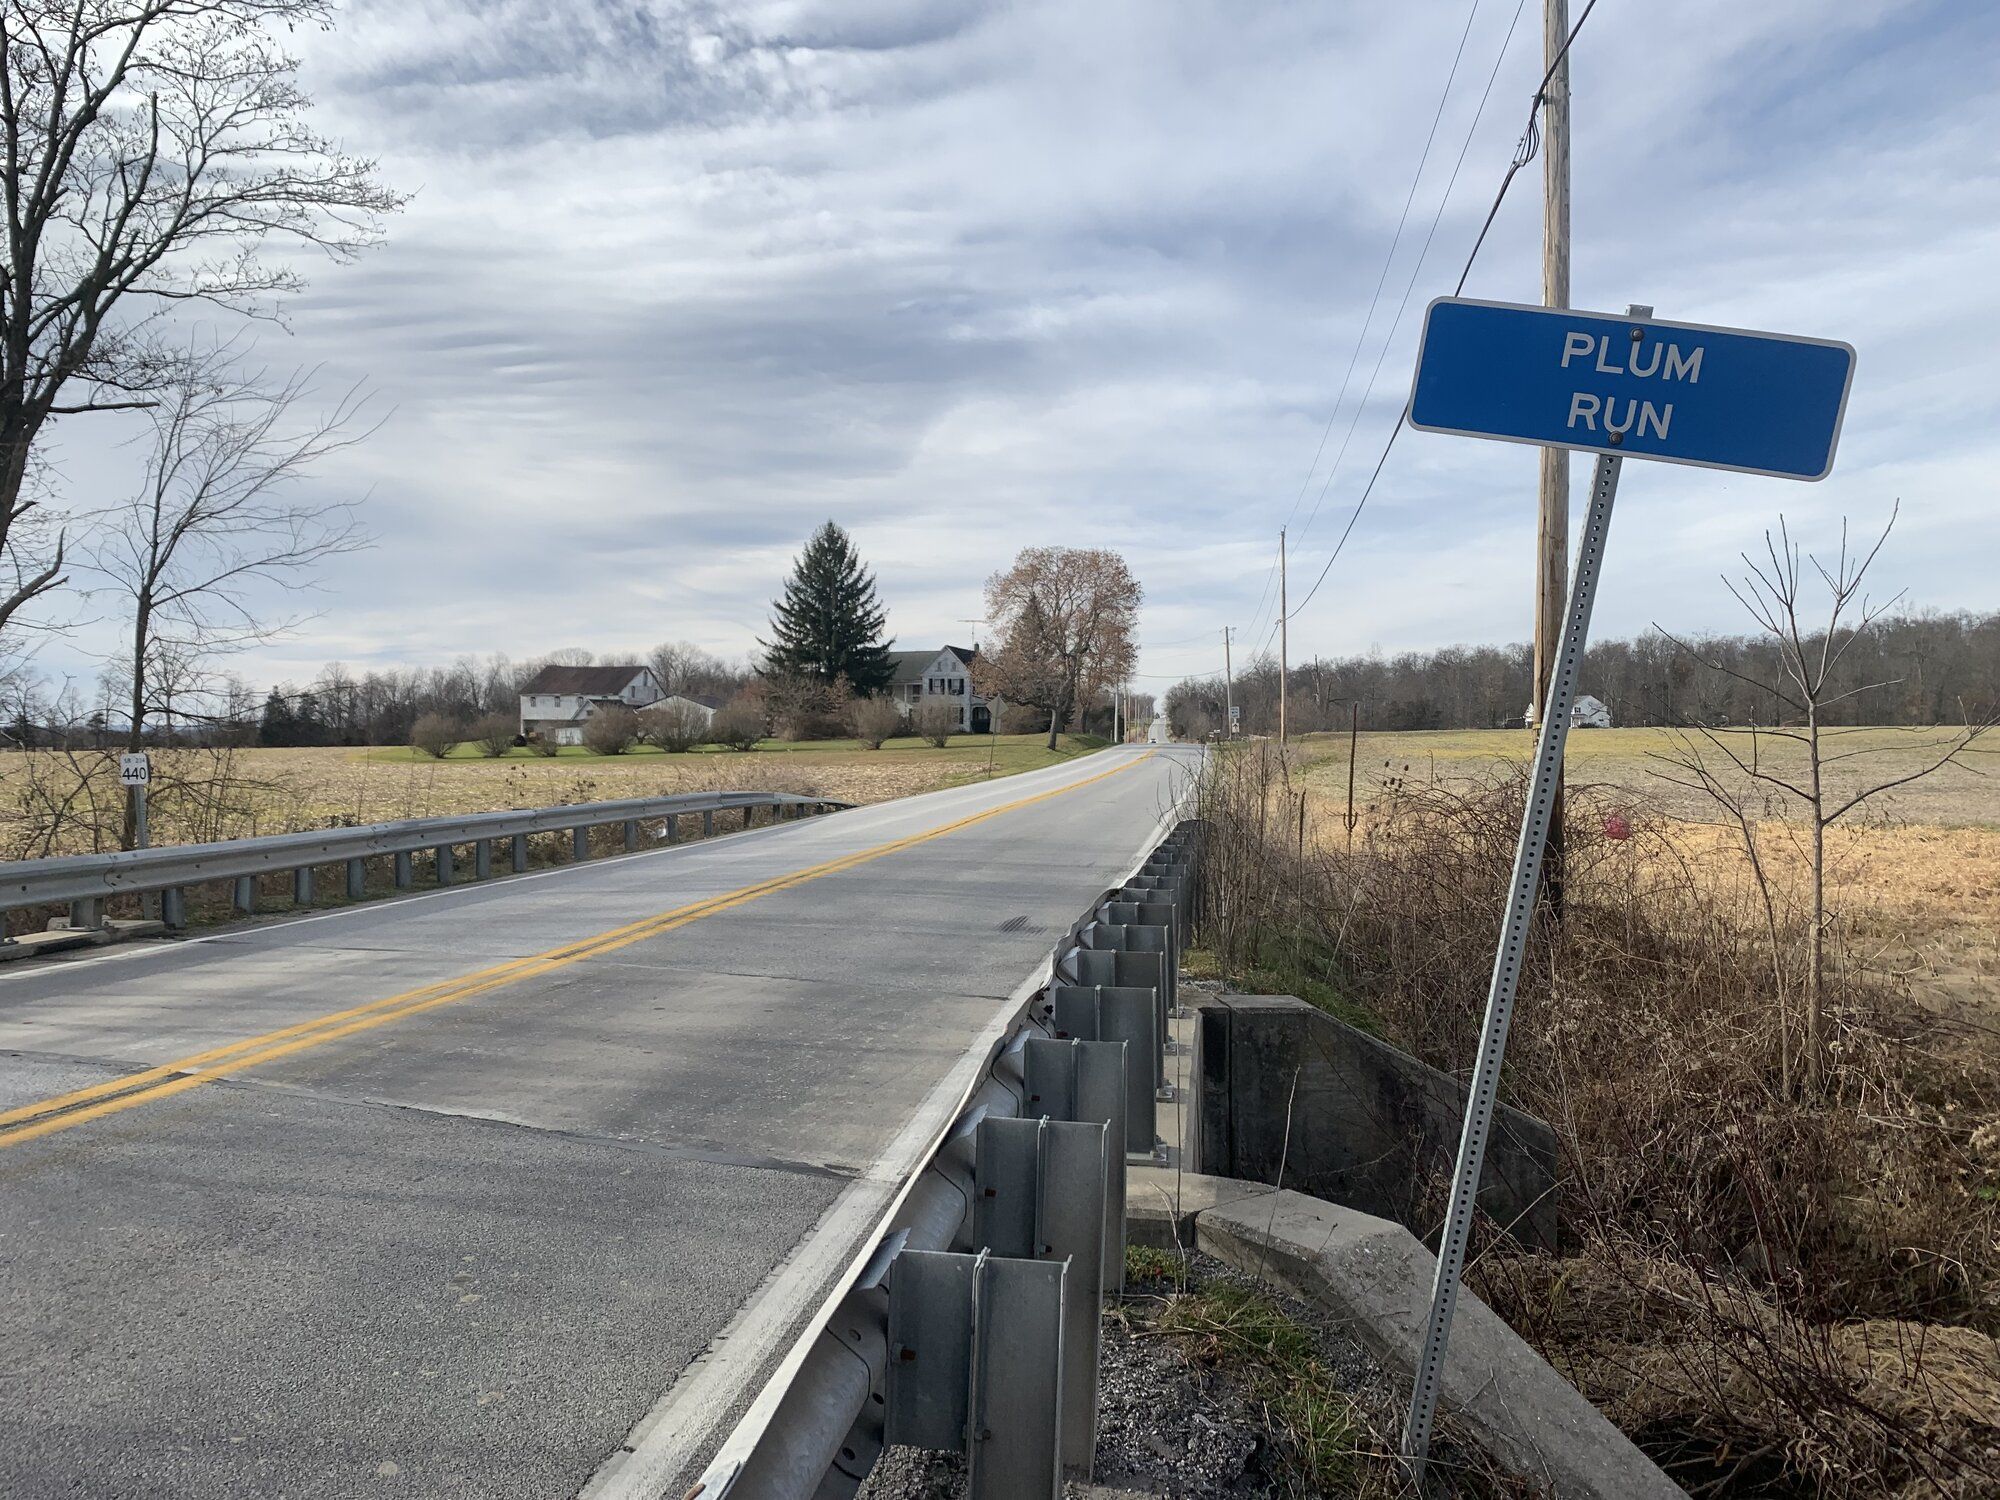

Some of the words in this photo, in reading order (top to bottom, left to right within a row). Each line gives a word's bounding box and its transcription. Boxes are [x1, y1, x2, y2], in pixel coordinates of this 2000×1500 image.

[1560, 331, 1705, 384] PLUM
[1566, 392, 1674, 440] RUN
[122, 767, 146, 780] 440
